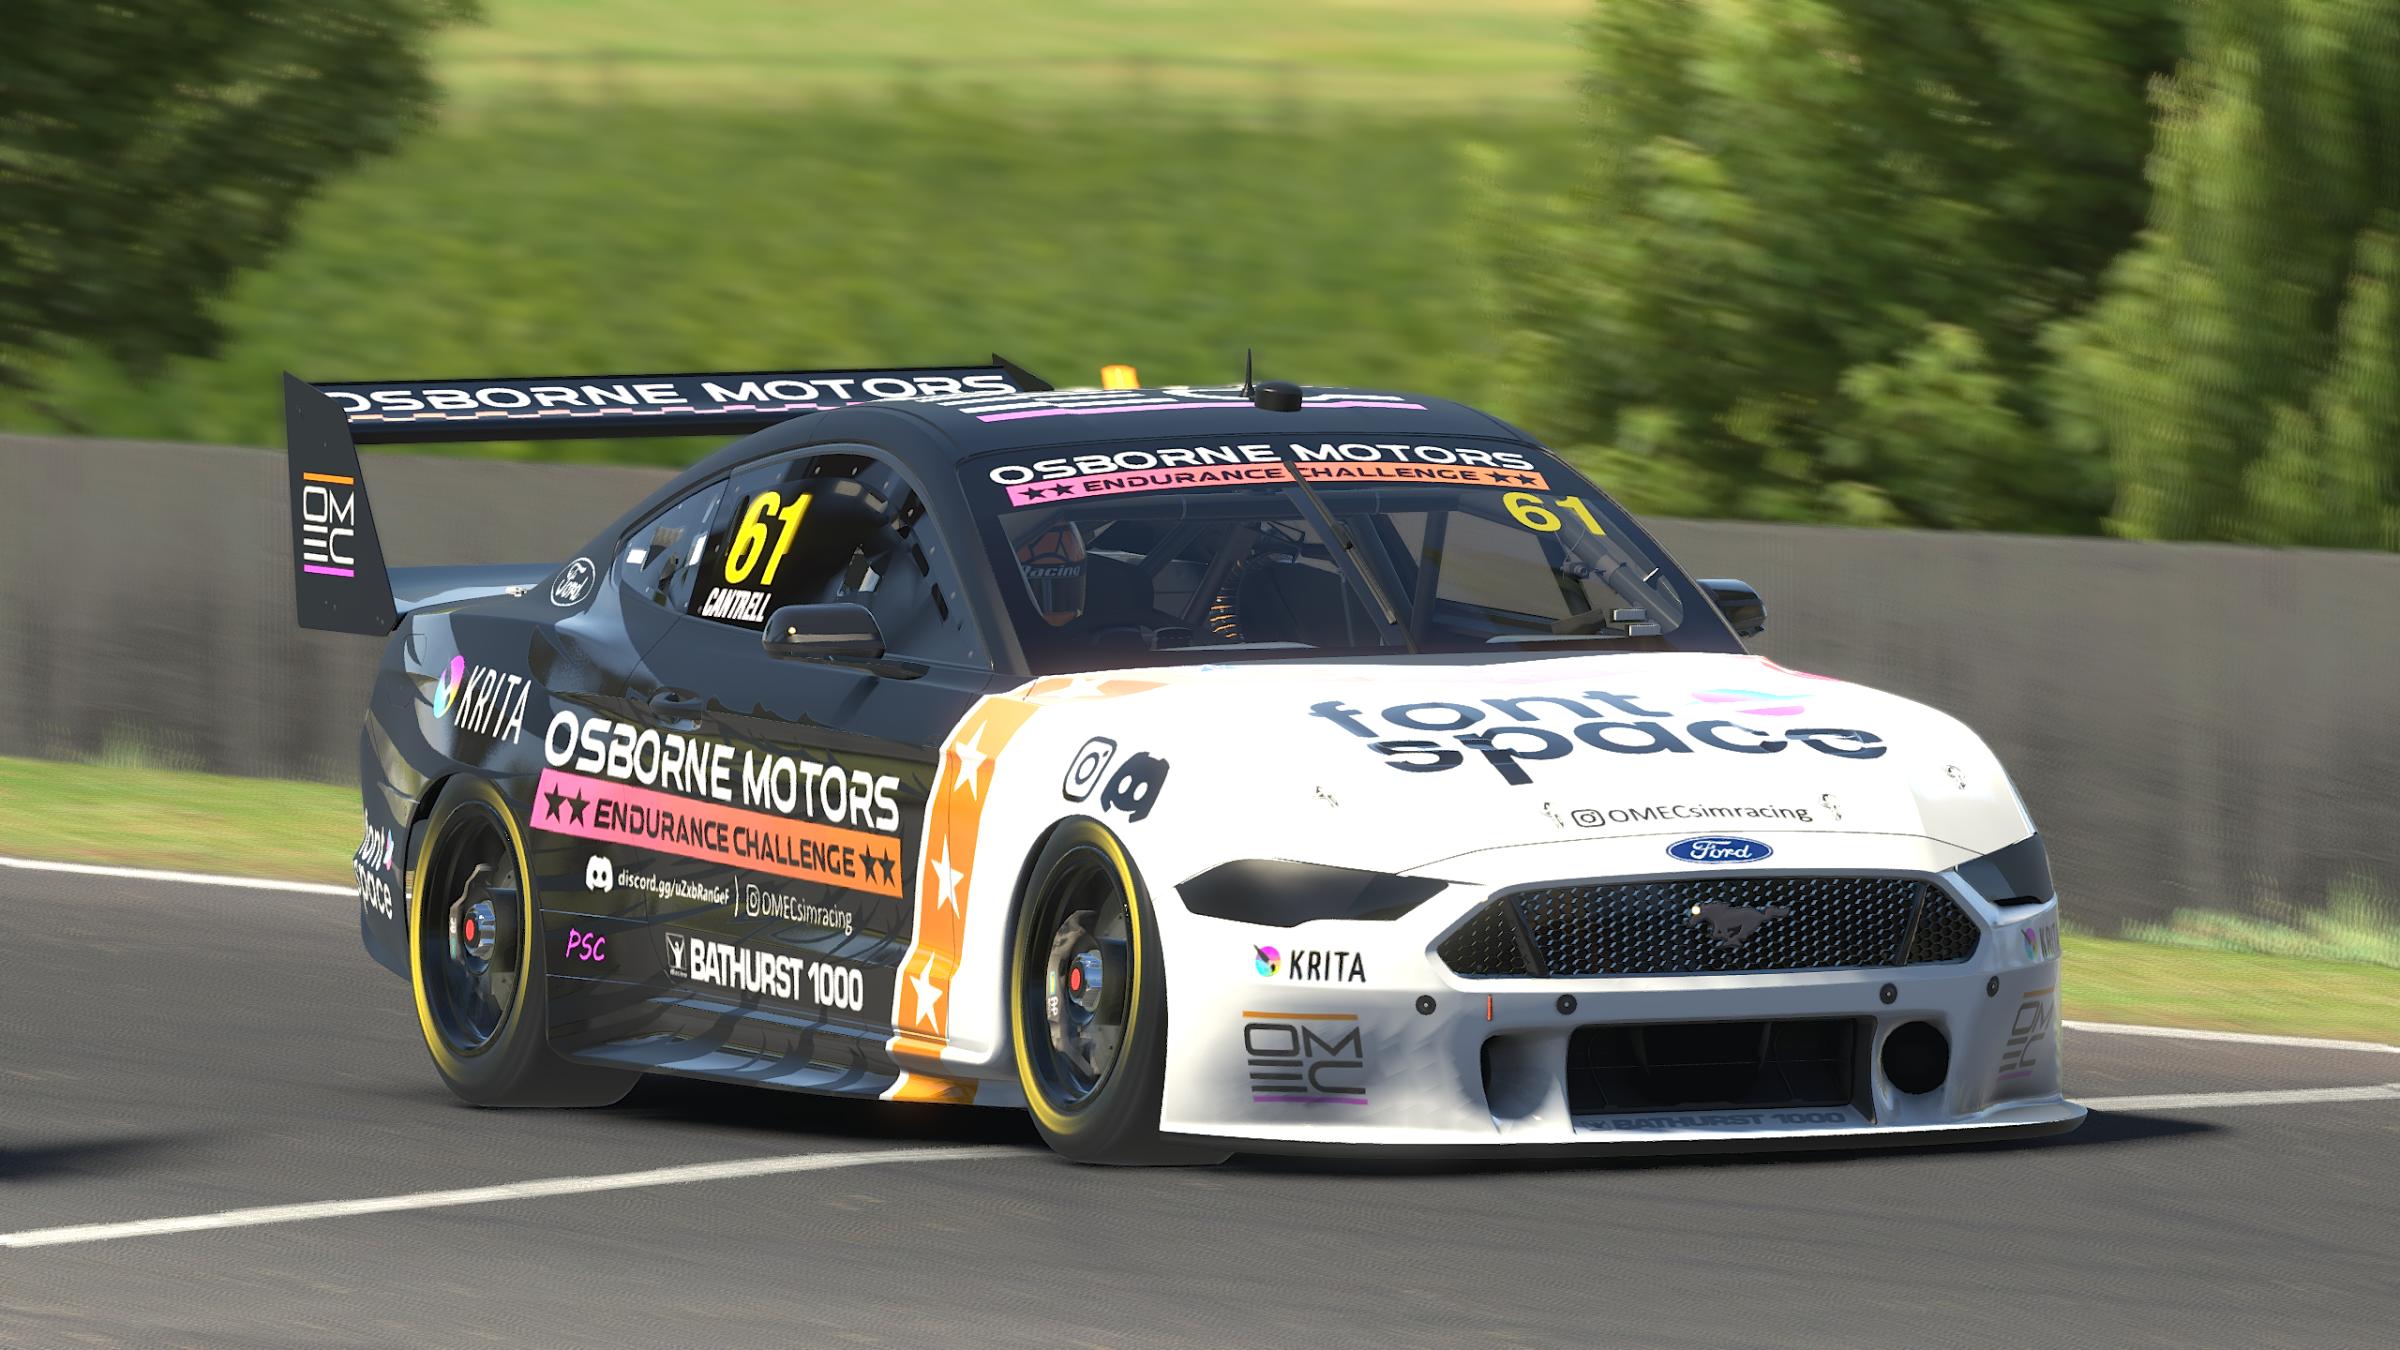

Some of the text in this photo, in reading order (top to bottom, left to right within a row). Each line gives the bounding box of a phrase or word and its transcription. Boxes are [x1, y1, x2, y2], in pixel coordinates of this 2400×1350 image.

[700, 375, 1017, 404] MOTORS
[989, 443, 1534, 485] OSBORNE MOTORS
[1083, 468, 1286, 492] ENDURANCE
[1503, 491, 1606, 536] 61
[724, 491, 812, 585] 61
[702, 587, 772, 622] CANTRELL
[454, 664, 532, 745] KRITA
[1309, 690, 1673, 737] font
[544, 710, 900, 832] OSBORNE MOTORS
[1367, 720, 1887, 785] space
[1608, 804, 1813, 822] OMECsimracing
[593, 797, 855, 878] ENDURANCE CHALLENGE
[1690, 840, 1752, 859] Ford
[565, 928, 606, 962] PSC
[690, 937, 865, 1012] BATHURST 1000
[1289, 949, 1366, 983] KRITA
[1244, 1022, 1363, 1058] OM
[1611, 1111, 1845, 1130] BATHURST 1000
